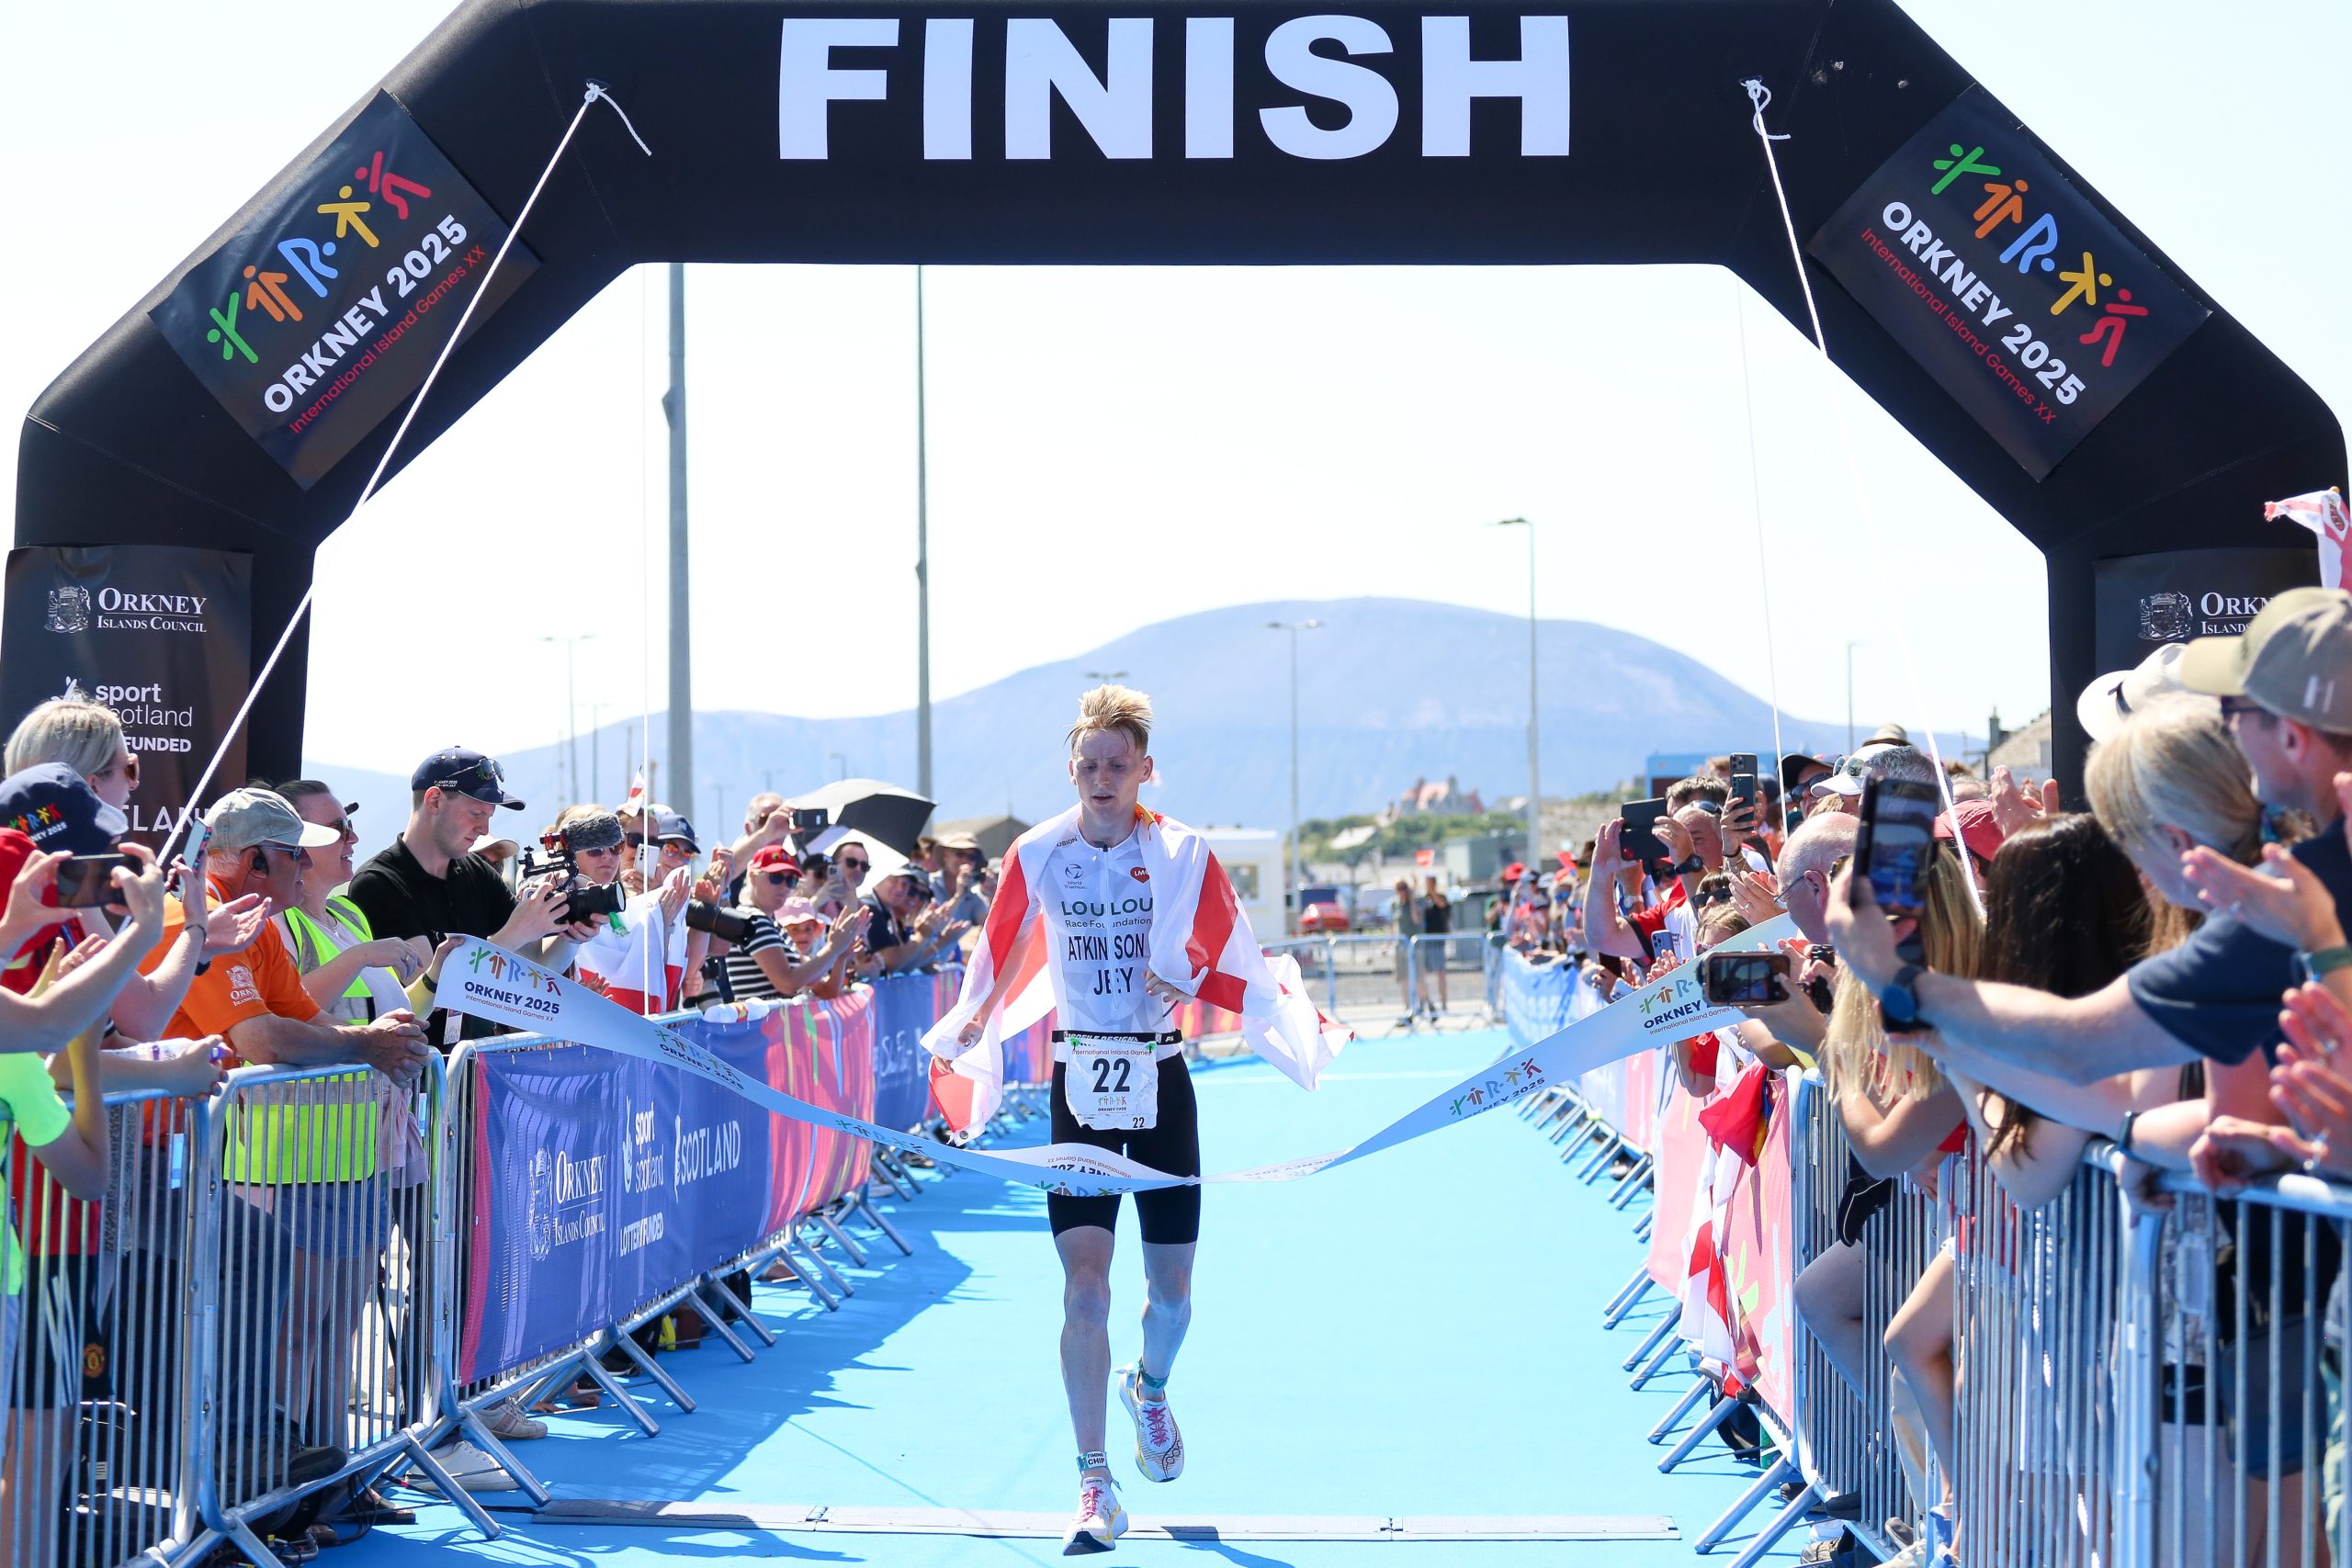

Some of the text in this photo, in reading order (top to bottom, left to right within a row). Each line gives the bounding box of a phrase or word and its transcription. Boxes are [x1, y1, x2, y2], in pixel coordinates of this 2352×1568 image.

[779, 15, 1570, 160] FINISH
[265, 214, 467, 412] ORKNEY 2025
[1883, 201, 2086, 405] ORKNEY 2025
[288, 244, 486, 434] International Island Games XX
[1861, 228, 2057, 425] International Island Games XX
[98, 587, 207, 615] ORKNEY
[96, 615, 207, 632] ISLANDS COUNCIL
[96, 683, 161, 705] sport
[1061, 897, 1154, 917] LOU LOU
[1065, 919, 1088, 929] Race
[464, 981, 560, 1015] ORKNEY 2025
[465, 994, 503, 1010] International
[503, 1004, 522, 1015] Island
[523, 1010, 545, 1021] Games
[1644, 999, 1702, 1029] ORKNEY
[1649, 1016, 1688, 1035] International
[1689, 1011, 1708, 1023] Island
[1708, 1007, 1730, 1017] Games
[659, 1043, 711, 1071] ORKNEY
[1092, 1058, 1131, 1093] 22
[1512, 1077, 1545, 1099] 2025
[635, 1101, 655, 1155] sport
[1133, 1117, 1145, 1128] 22
[635, 1144, 664, 1194] scotland
[680, 1120, 741, 1186] SCOTLAND
[556, 1150, 606, 1204] ORKNEY
[555, 1210, 605, 1247] ISLANDS COUNCIL
